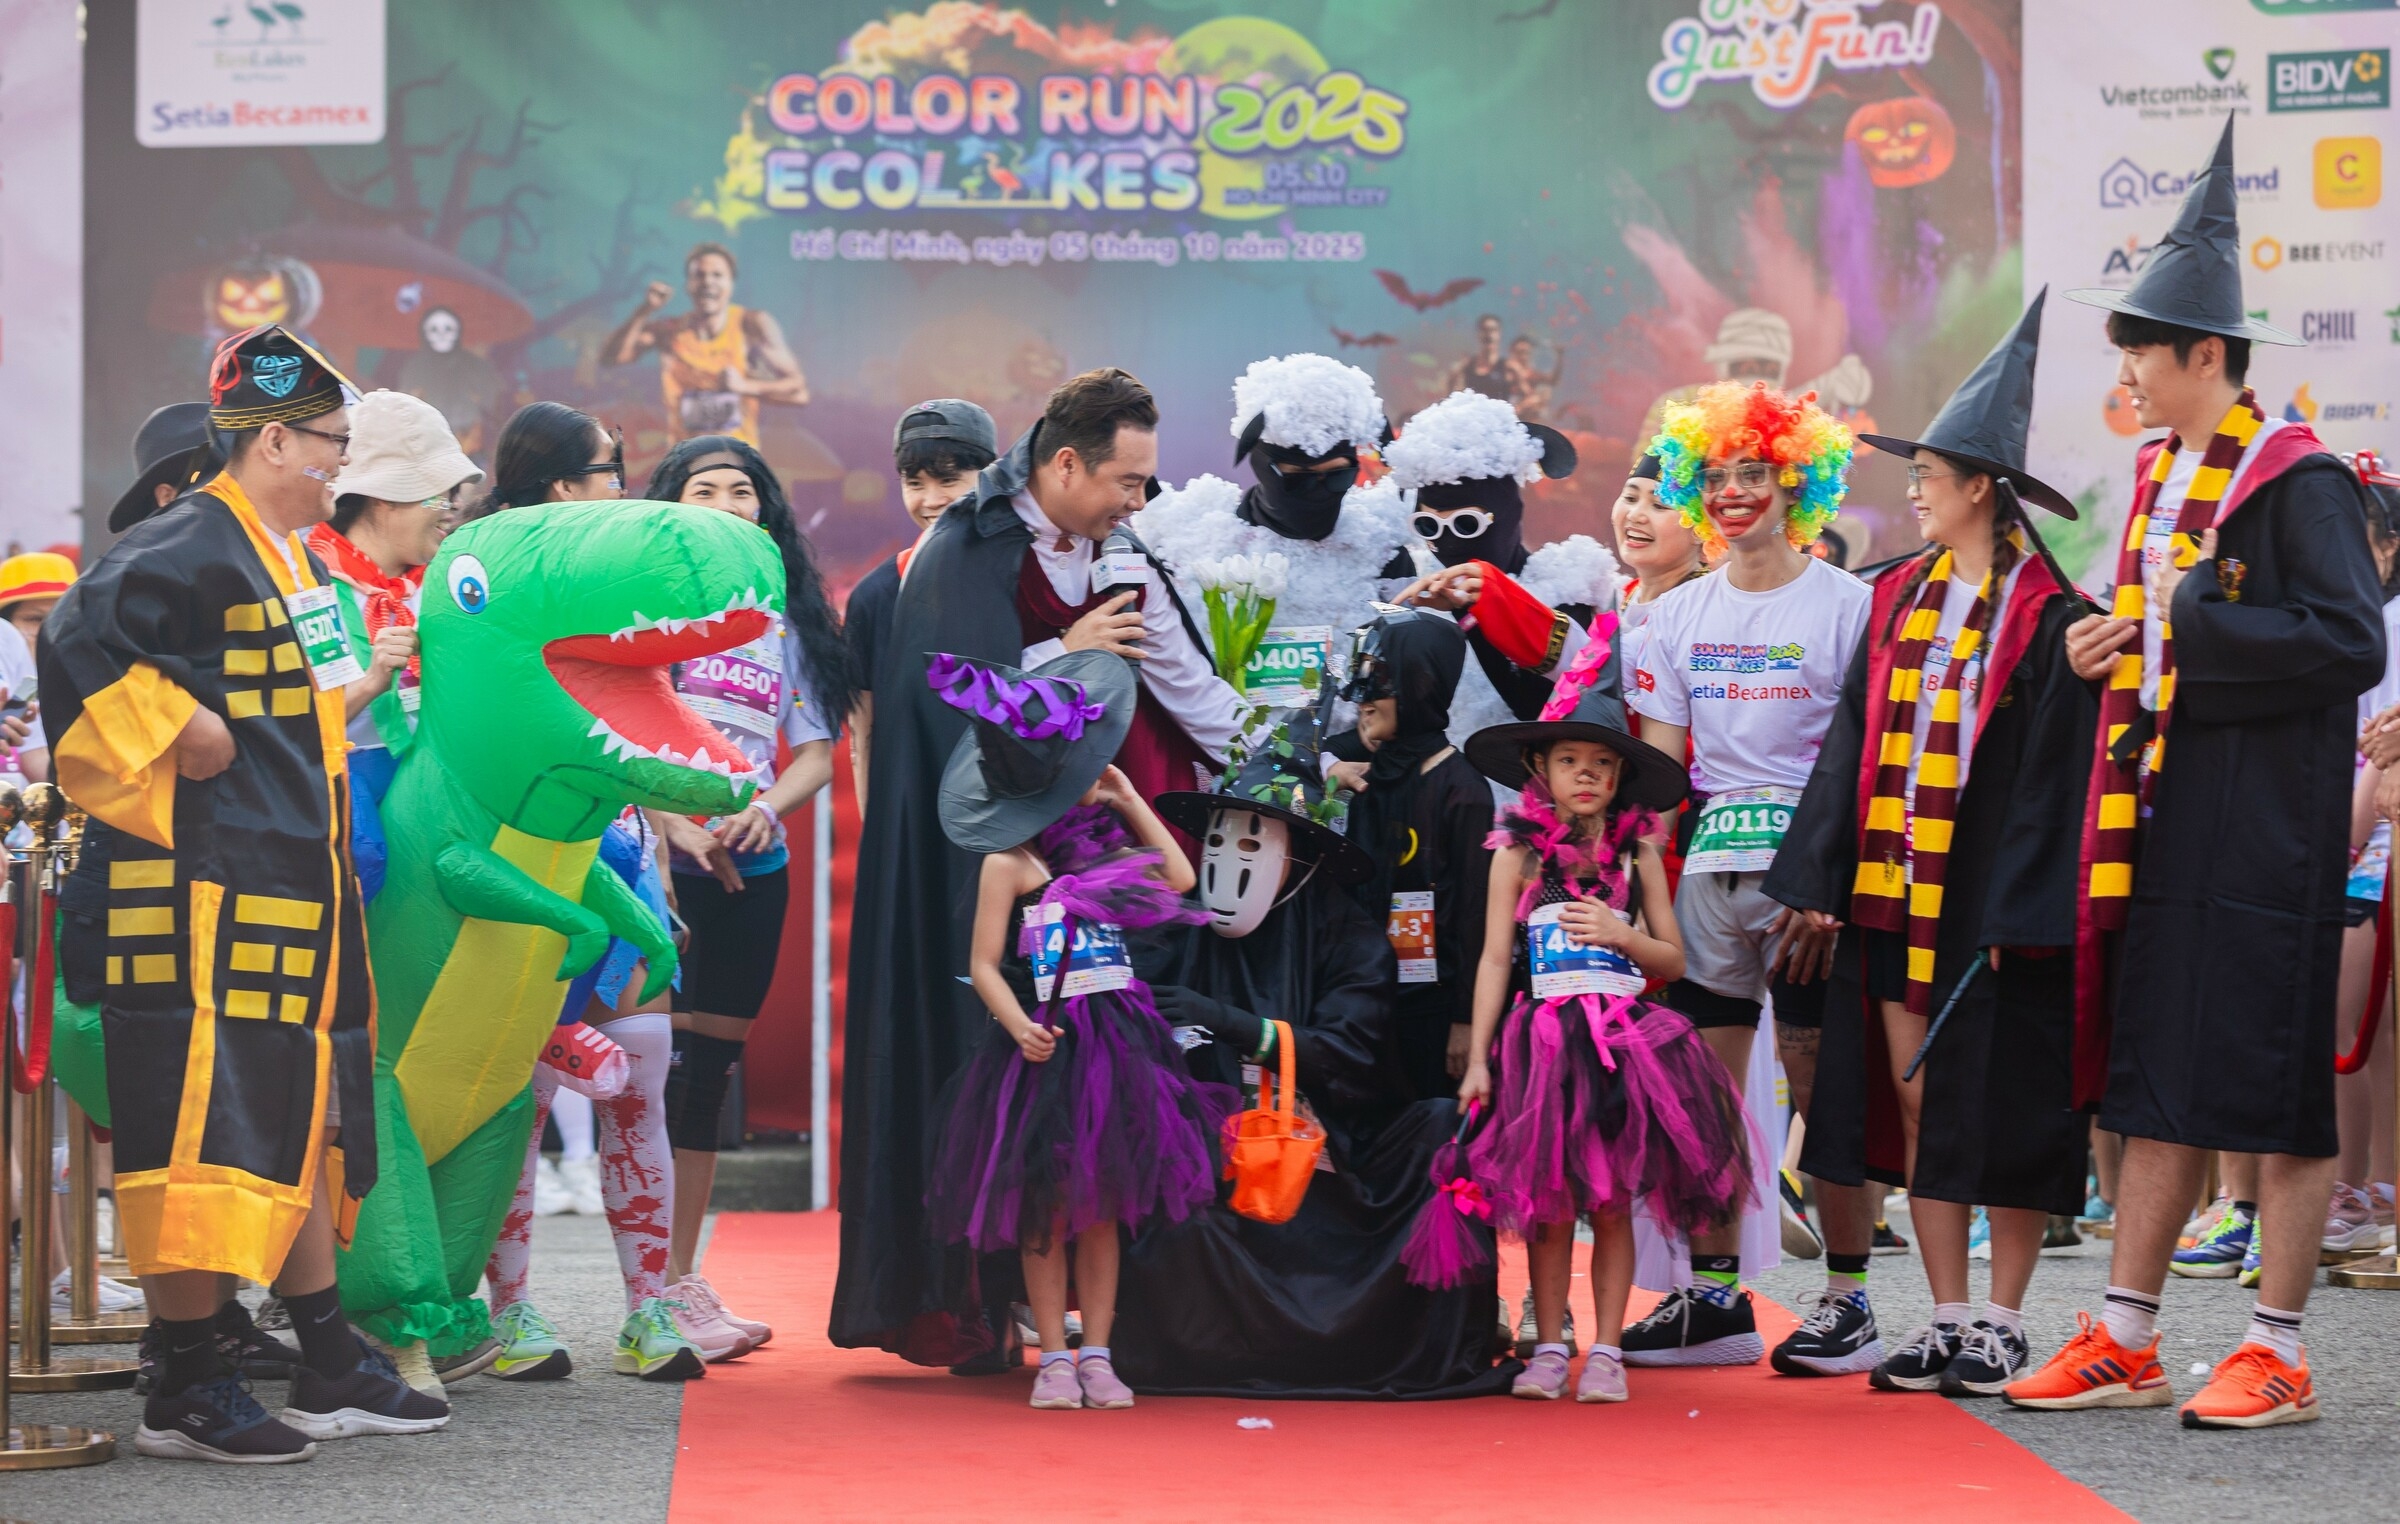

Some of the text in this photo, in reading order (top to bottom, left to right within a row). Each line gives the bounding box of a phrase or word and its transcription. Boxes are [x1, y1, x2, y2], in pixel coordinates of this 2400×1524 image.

[1656, 9, 1936, 99] Just Fun!
[2276, 59, 2352, 93] BIDV
[2101, 81, 2249, 107] Vietcombank
[151, 101, 370, 132] SetiaBecamex
[768, 71, 1408, 155] COLOR RUN 2025
[2151, 167, 2280, 196] Cafand
[973, 229, 1046, 266] ngày
[1049, 231, 1090, 260] 05
[1091, 228, 1180, 266] tháng
[1182, 231, 1220, 260] 10
[1223, 229, 1289, 260] năm
[1291, 231, 1366, 261] 2025
[2289, 240, 2386, 262] BEE EVENT
[1691, 642, 1805, 661] COLOR RUN 2025
[690, 657, 772, 695] 20450
[1703, 808, 1792, 836] 10119
